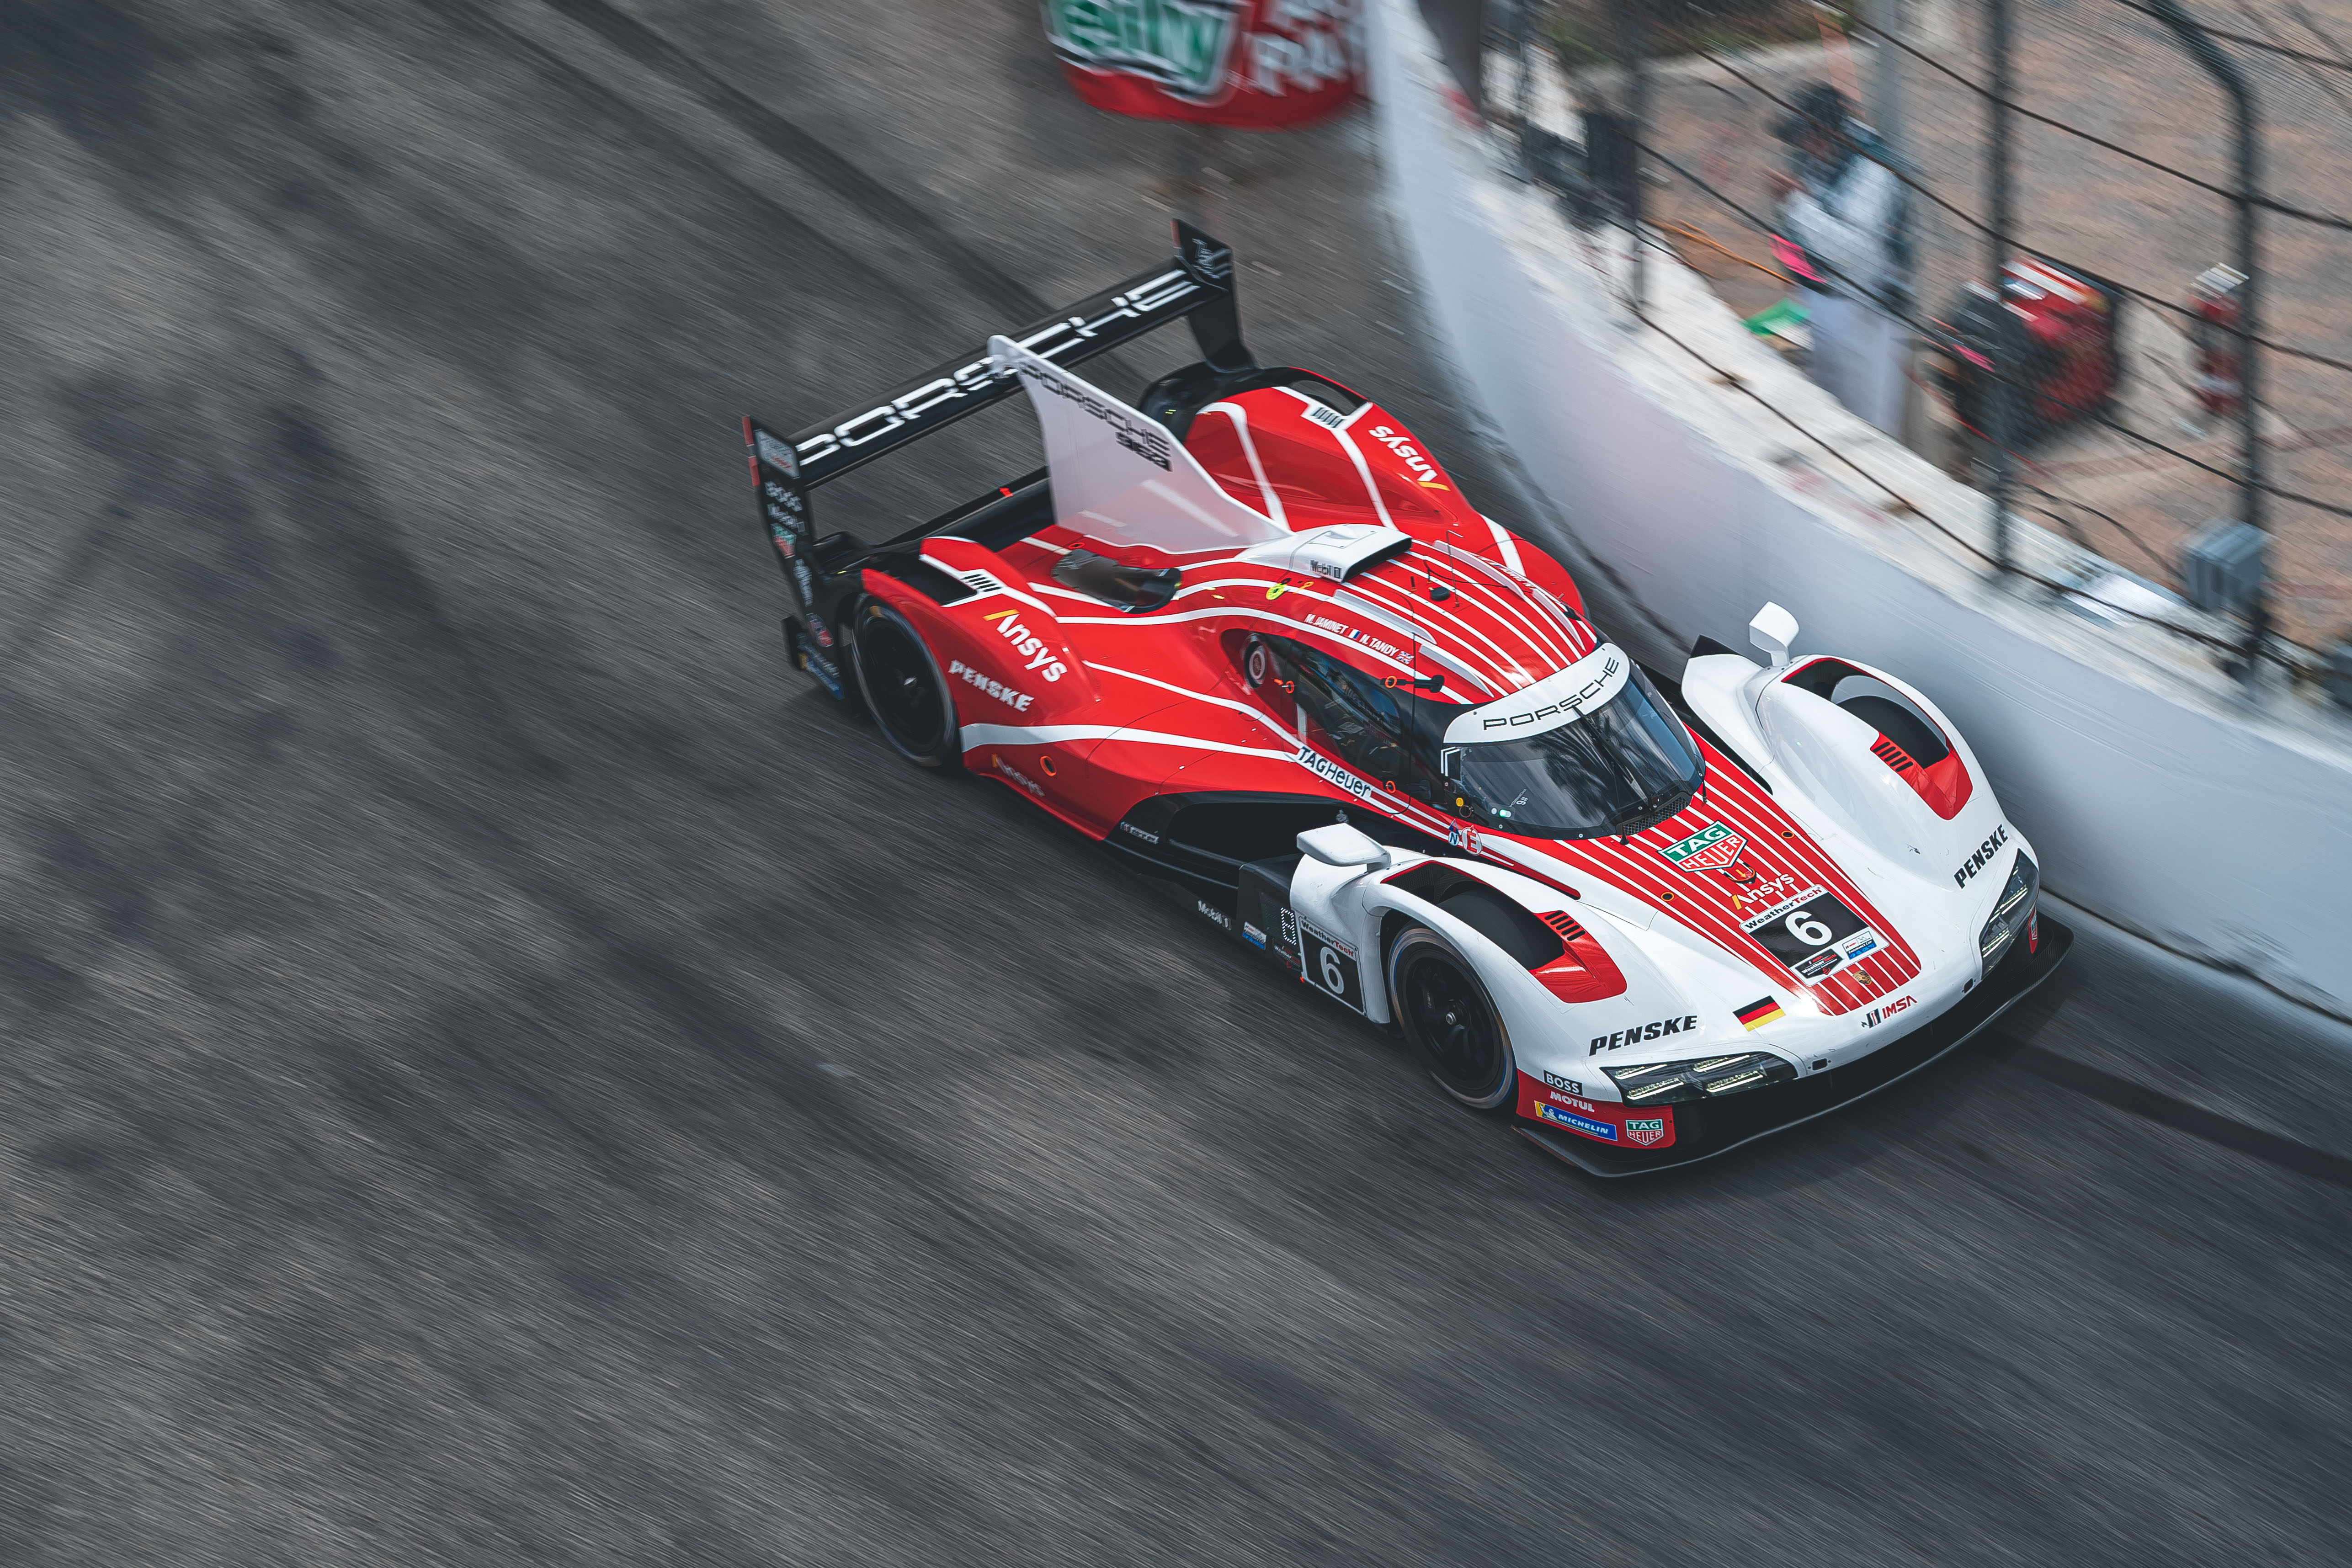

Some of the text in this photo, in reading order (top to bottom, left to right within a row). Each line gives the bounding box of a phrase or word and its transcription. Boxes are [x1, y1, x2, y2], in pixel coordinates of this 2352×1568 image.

[795, 269, 1201, 466] PORSCHE
[1019, 361, 1171, 457] PORSCHE
[1115, 432, 1172, 472] 963
[1368, 425, 1451, 492] Ansys
[982, 609, 1068, 683] Ansys
[1368, 638, 1400, 657] TANDY
[947, 659, 1035, 712] PENSKE
[1483, 656, 1619, 731] PORSCHE
[1449, 833, 1457, 844] N
[1467, 830, 1477, 853] E
[1667, 827, 1727, 856] TAG
[1681, 836, 1740, 868] HEUER
[1953, 824, 2008, 889] PENSKE
[1732, 873, 1795, 910] Ansys
[1745, 887, 1822, 929] WeatherTech
[1301, 920, 1354, 957] WeatherTech
[1785, 911, 1832, 946] 6
[1320, 947, 1344, 994] 6
[1882, 995, 1918, 1019] IMSA
[1589, 1015, 1697, 1056] PENSKE
[1546, 1074, 1579, 1094] BOSS
[1550, 1091, 1595, 1112] MOTUL
[1558, 1114, 1608, 1134] MICHELIN
[1629, 1121, 1659, 1129] TAG
[1629, 1130, 1662, 1143] HEUER
